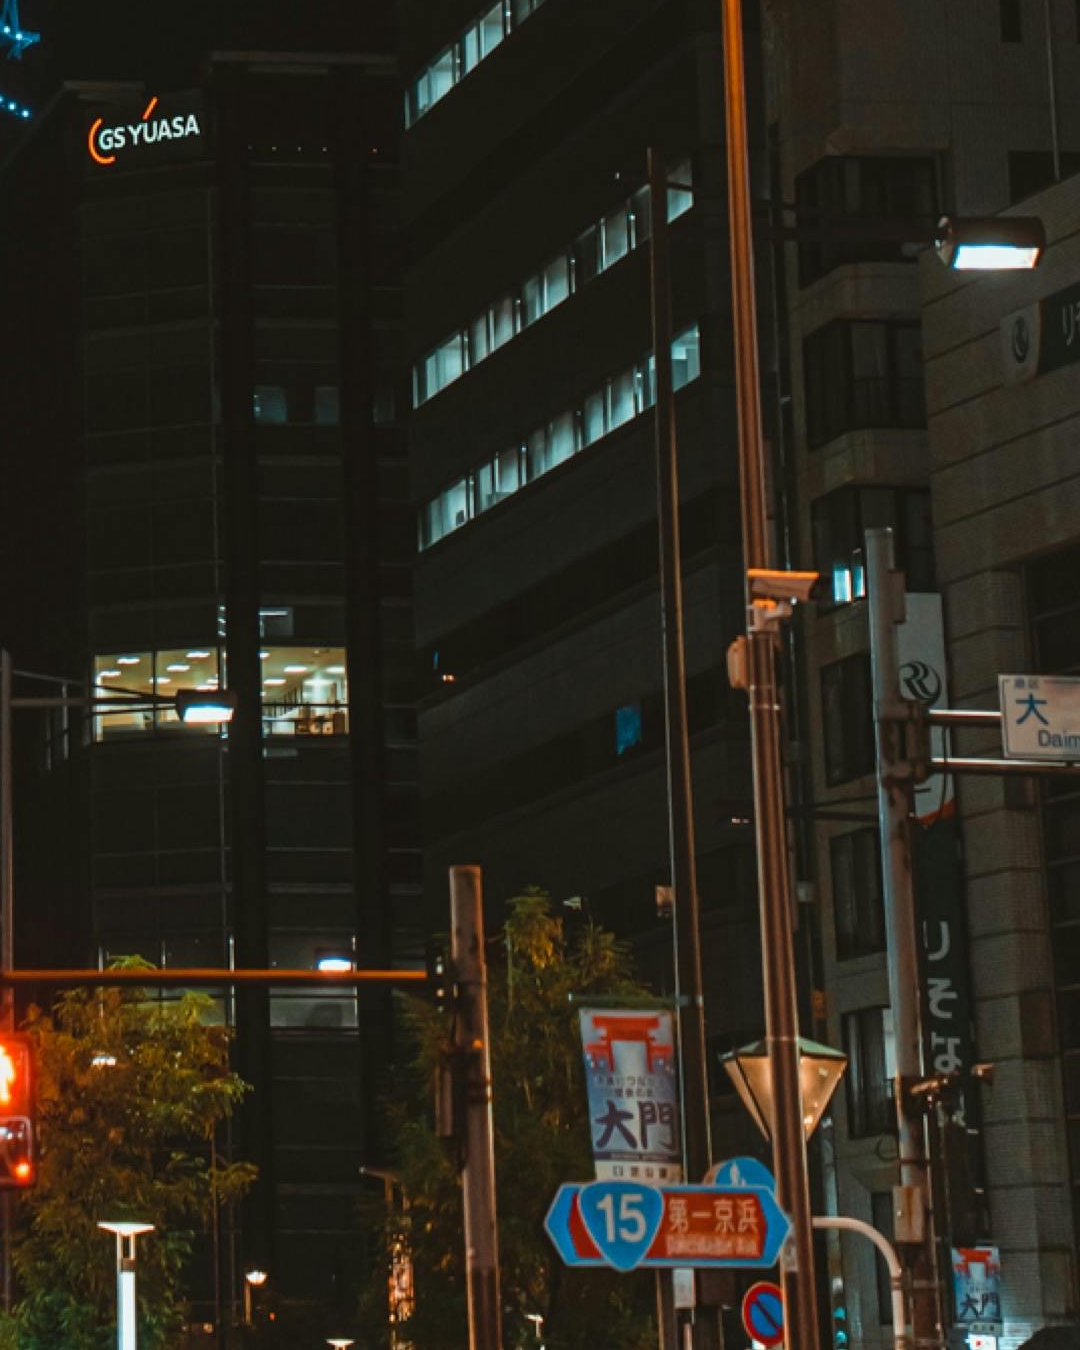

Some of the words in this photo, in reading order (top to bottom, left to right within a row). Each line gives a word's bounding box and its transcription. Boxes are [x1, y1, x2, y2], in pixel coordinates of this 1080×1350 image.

[98, 127, 126, 151] GS
[127, 114, 201, 146] YUASA
[594, 1099, 676, 1150] 大門
[596, 1193, 648, 1244] 15
[669, 1197, 760, 1234] 第一京浜
